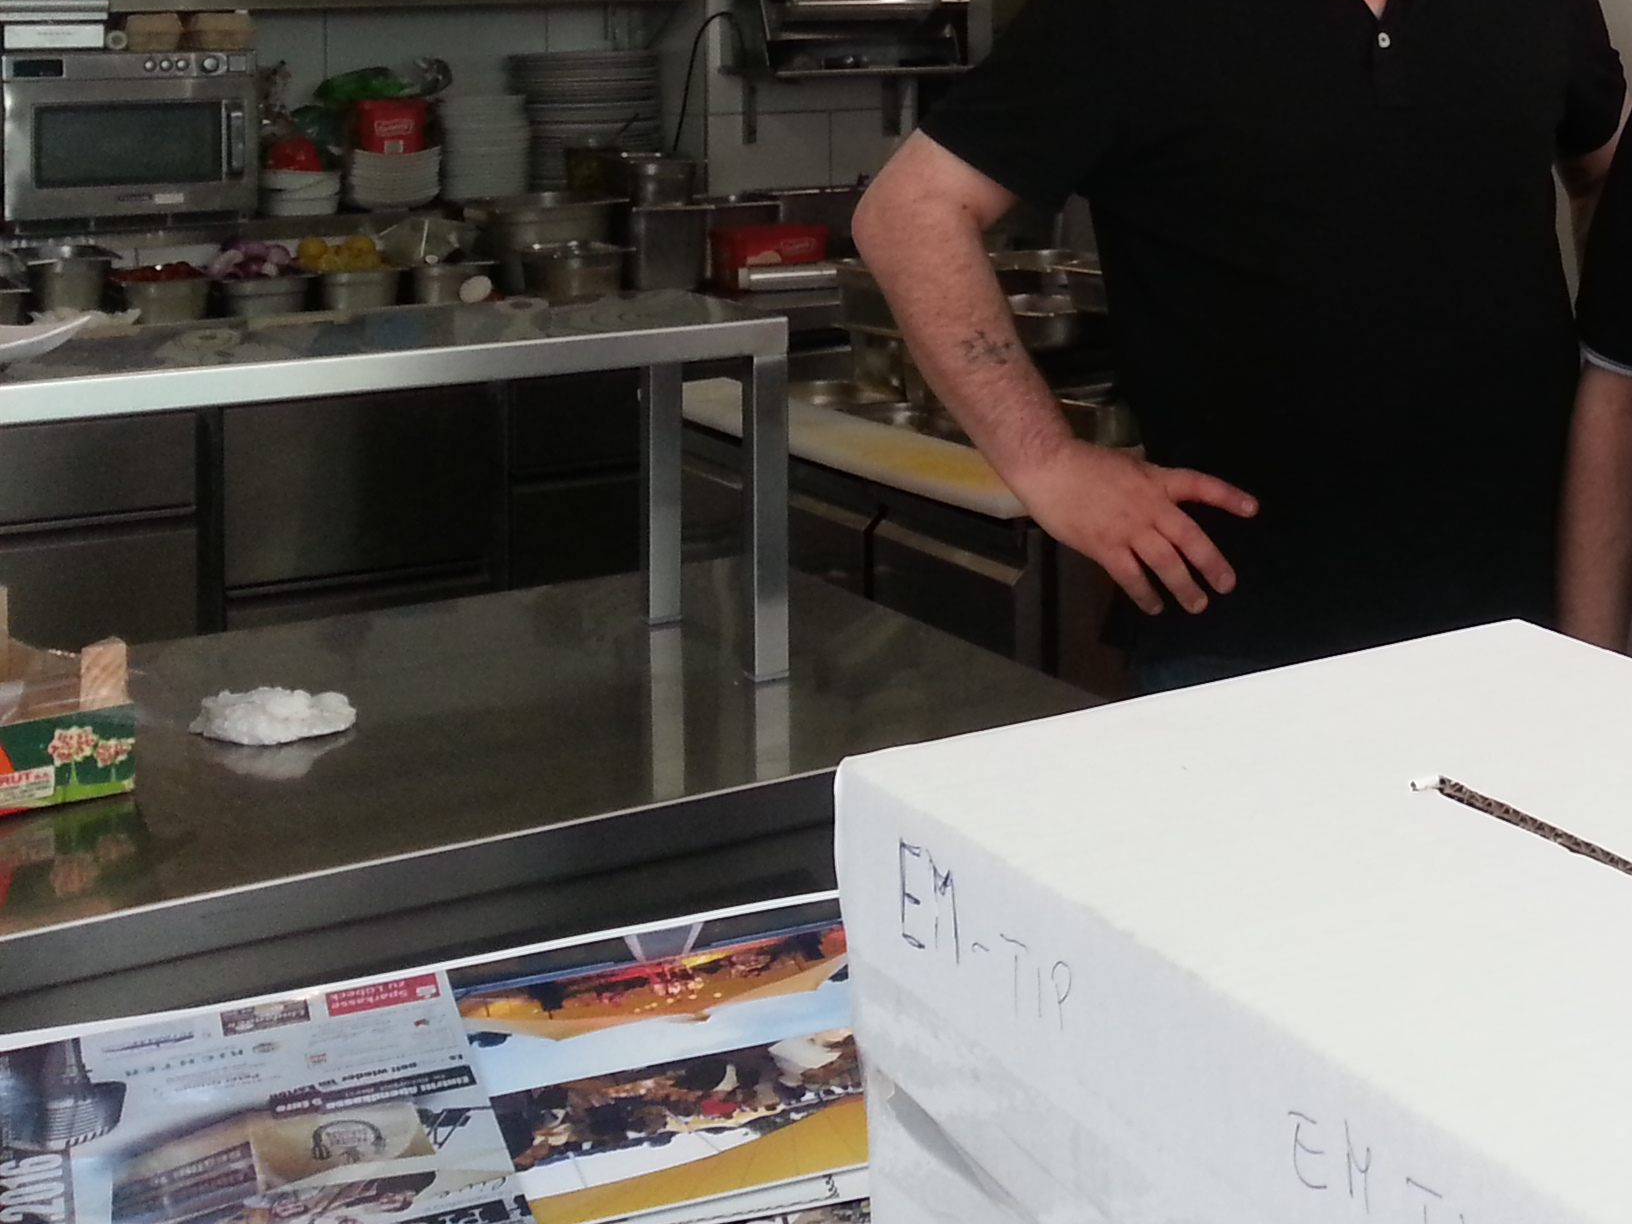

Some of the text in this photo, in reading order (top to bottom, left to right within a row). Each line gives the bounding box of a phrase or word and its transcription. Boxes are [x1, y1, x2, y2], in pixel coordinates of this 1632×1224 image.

[329, 980, 406, 1002] zu Lübeck
[330, 988, 408, 1010] Sparkasse
[419, 1074, 470, 1094] Eintritt
[325, 1084, 419, 1110] Abendkasse
